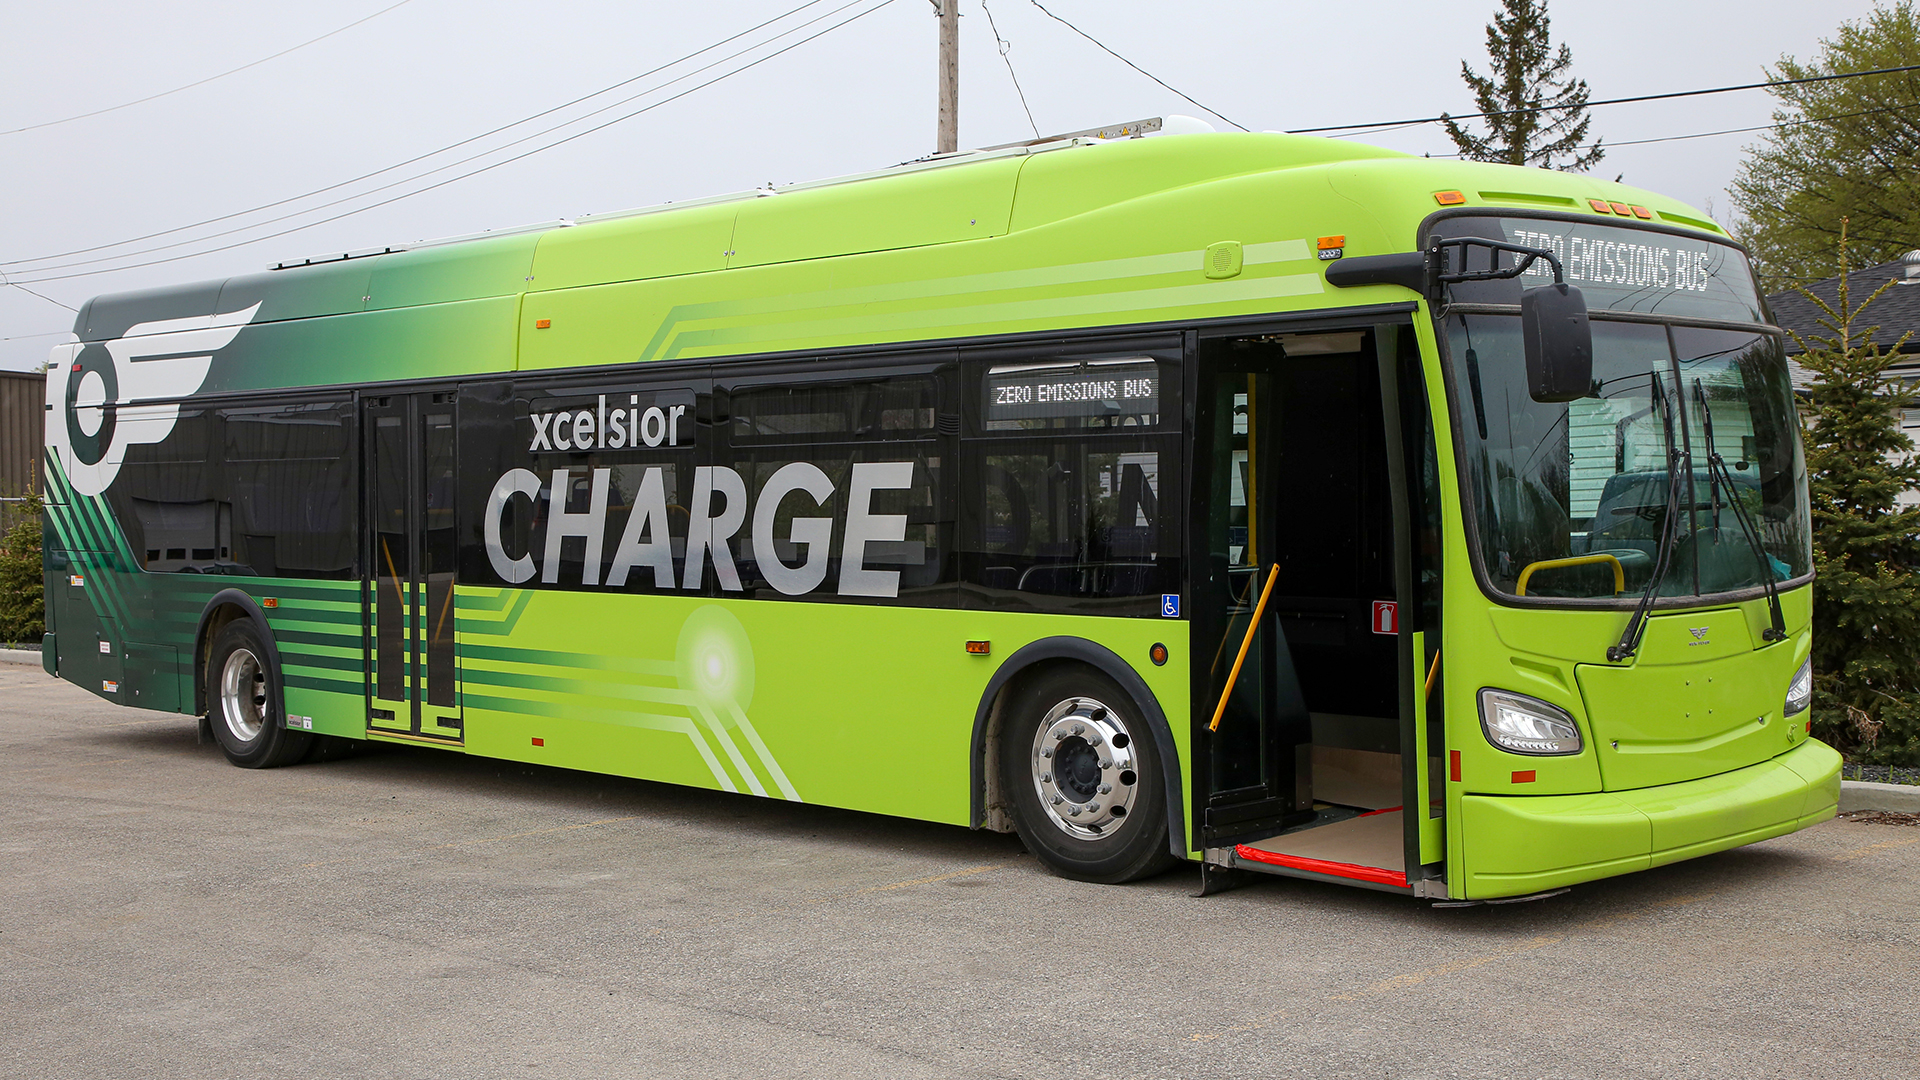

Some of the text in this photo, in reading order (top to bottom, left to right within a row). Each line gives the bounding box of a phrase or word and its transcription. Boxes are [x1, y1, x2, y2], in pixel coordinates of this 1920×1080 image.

[1569, 236, 1670, 288] EMISSIONS
[1675, 249, 1709, 292] BUS
[996, 378, 1152, 404] ZERO EMISSIONS BUS
[529, 394, 686, 452] xcelsior
[483, 461, 915, 598] CHARGE
